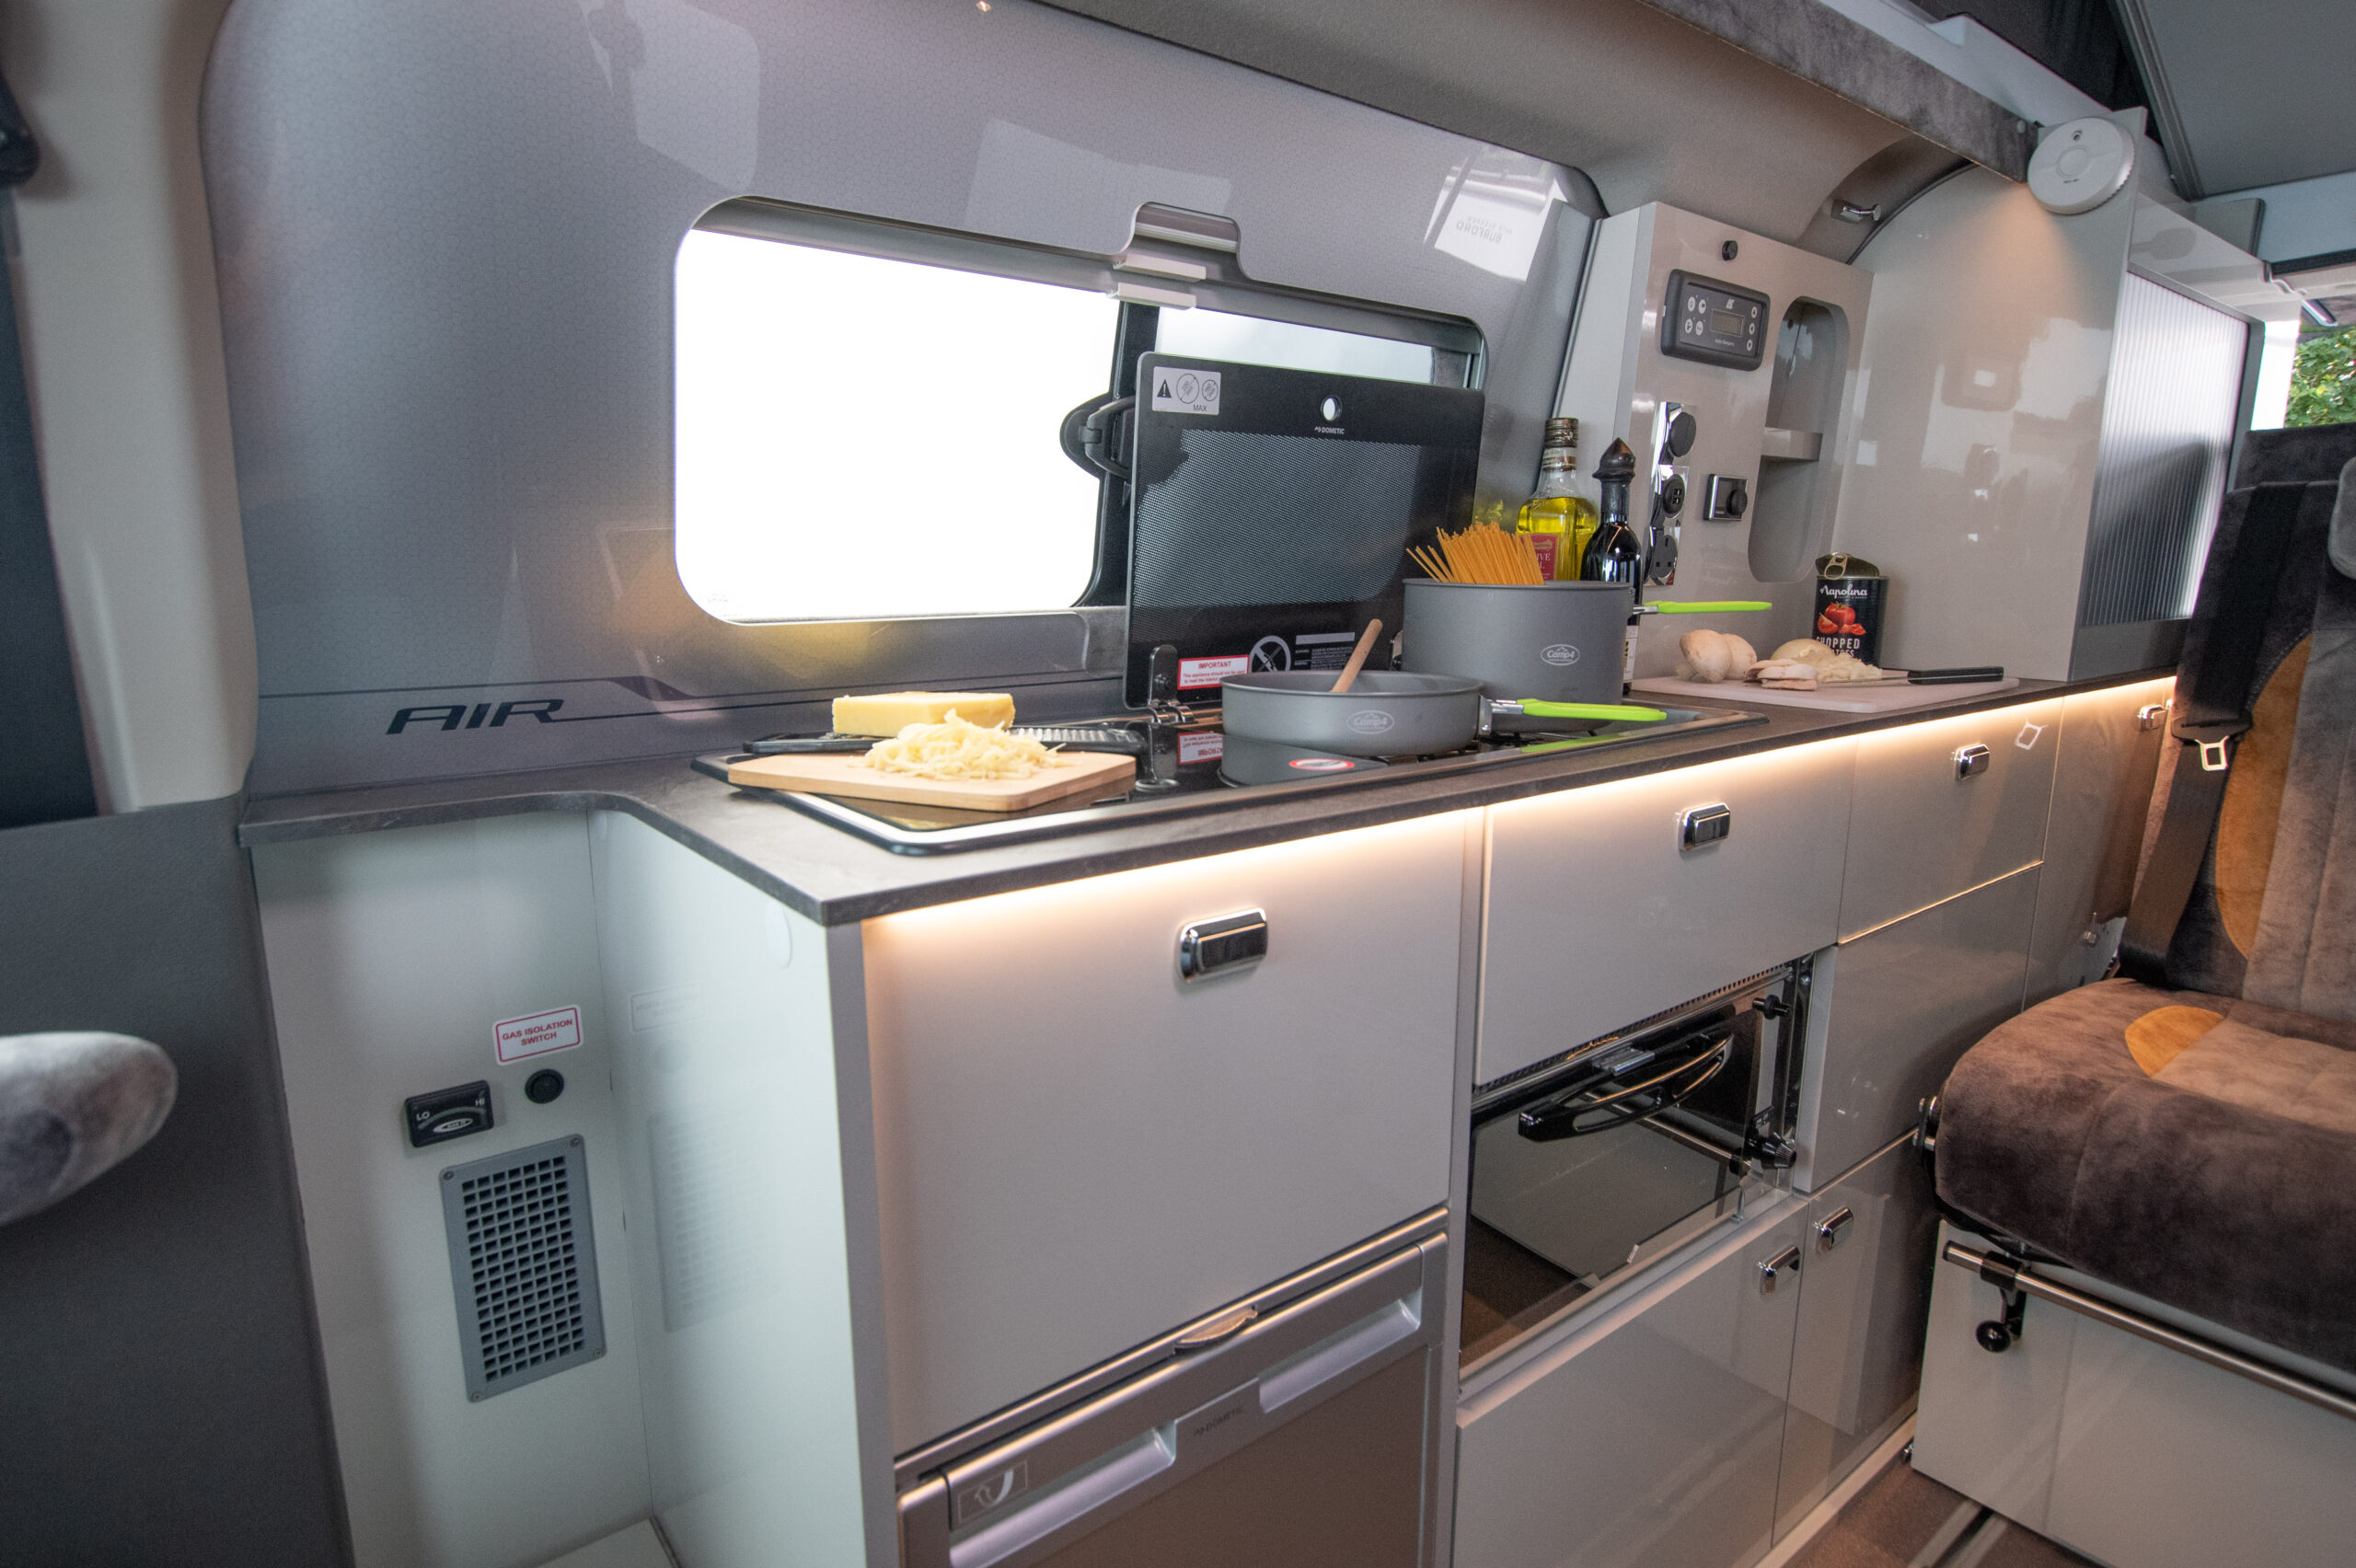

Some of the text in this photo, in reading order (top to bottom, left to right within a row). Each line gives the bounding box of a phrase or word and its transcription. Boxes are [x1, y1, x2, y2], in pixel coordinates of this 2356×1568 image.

[1193, 404, 1207, 412] MAX
[1819, 583, 1868, 599] Napolina
[1198, 661, 1231, 669] IMPORTANT
[386, 698, 564, 734] AIR
[502, 1019, 573, 1041] GAS ISOLATION
[521, 1031, 558, 1046] SWITCH
[475, 1098, 485, 1106] HI
[416, 1111, 431, 1121] LO
